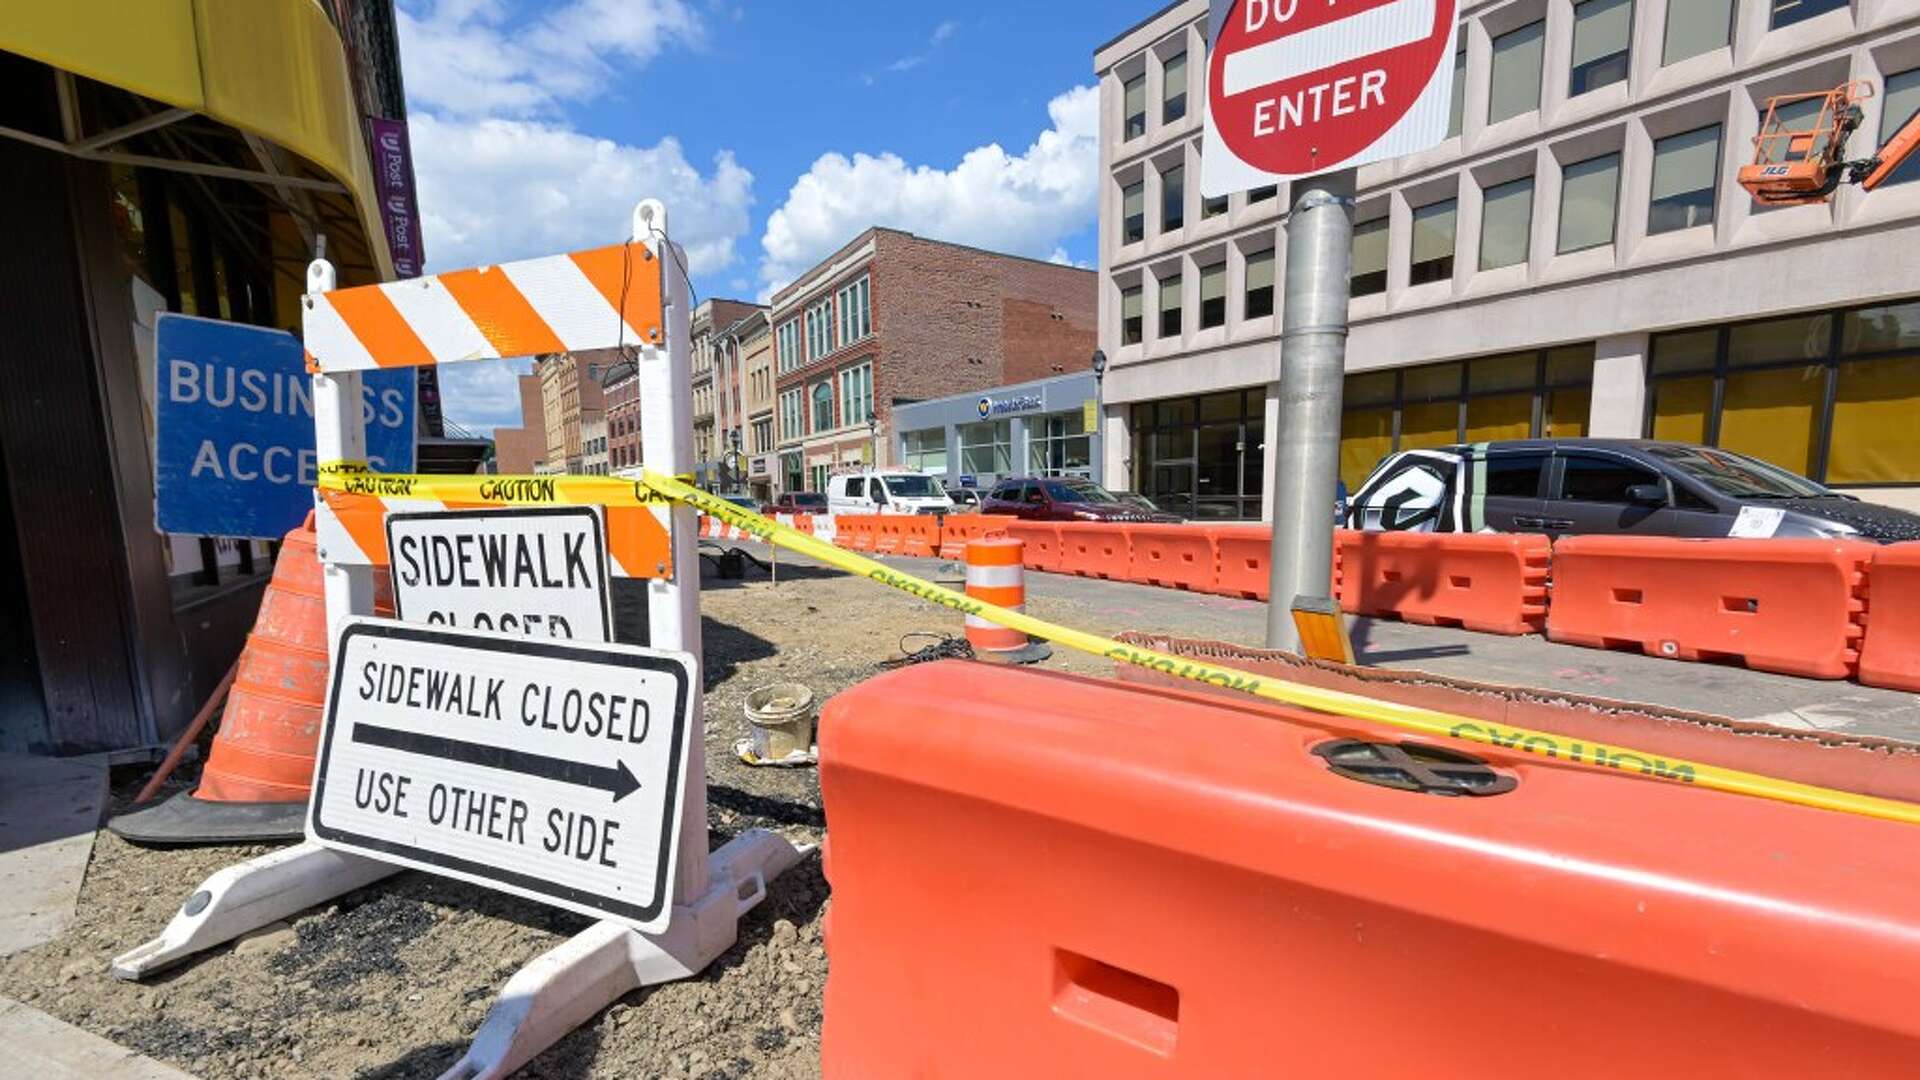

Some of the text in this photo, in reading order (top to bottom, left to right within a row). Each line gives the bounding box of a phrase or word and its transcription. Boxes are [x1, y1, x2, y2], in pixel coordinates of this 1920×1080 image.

[1253, 68, 1388, 138] ENTER
[387, 153, 404, 188] Post
[1760, 166, 1789, 175] JLG
[395, 215, 410, 249] Post
[169, 360, 405, 428] BUSINSS
[480, 480, 555, 501] CAUTION
[399, 532, 592, 589] SIDEWALK
[359, 661, 650, 745] SIDEWALK CLOSED
[355, 768, 620, 868] USE OTHER SIDE
